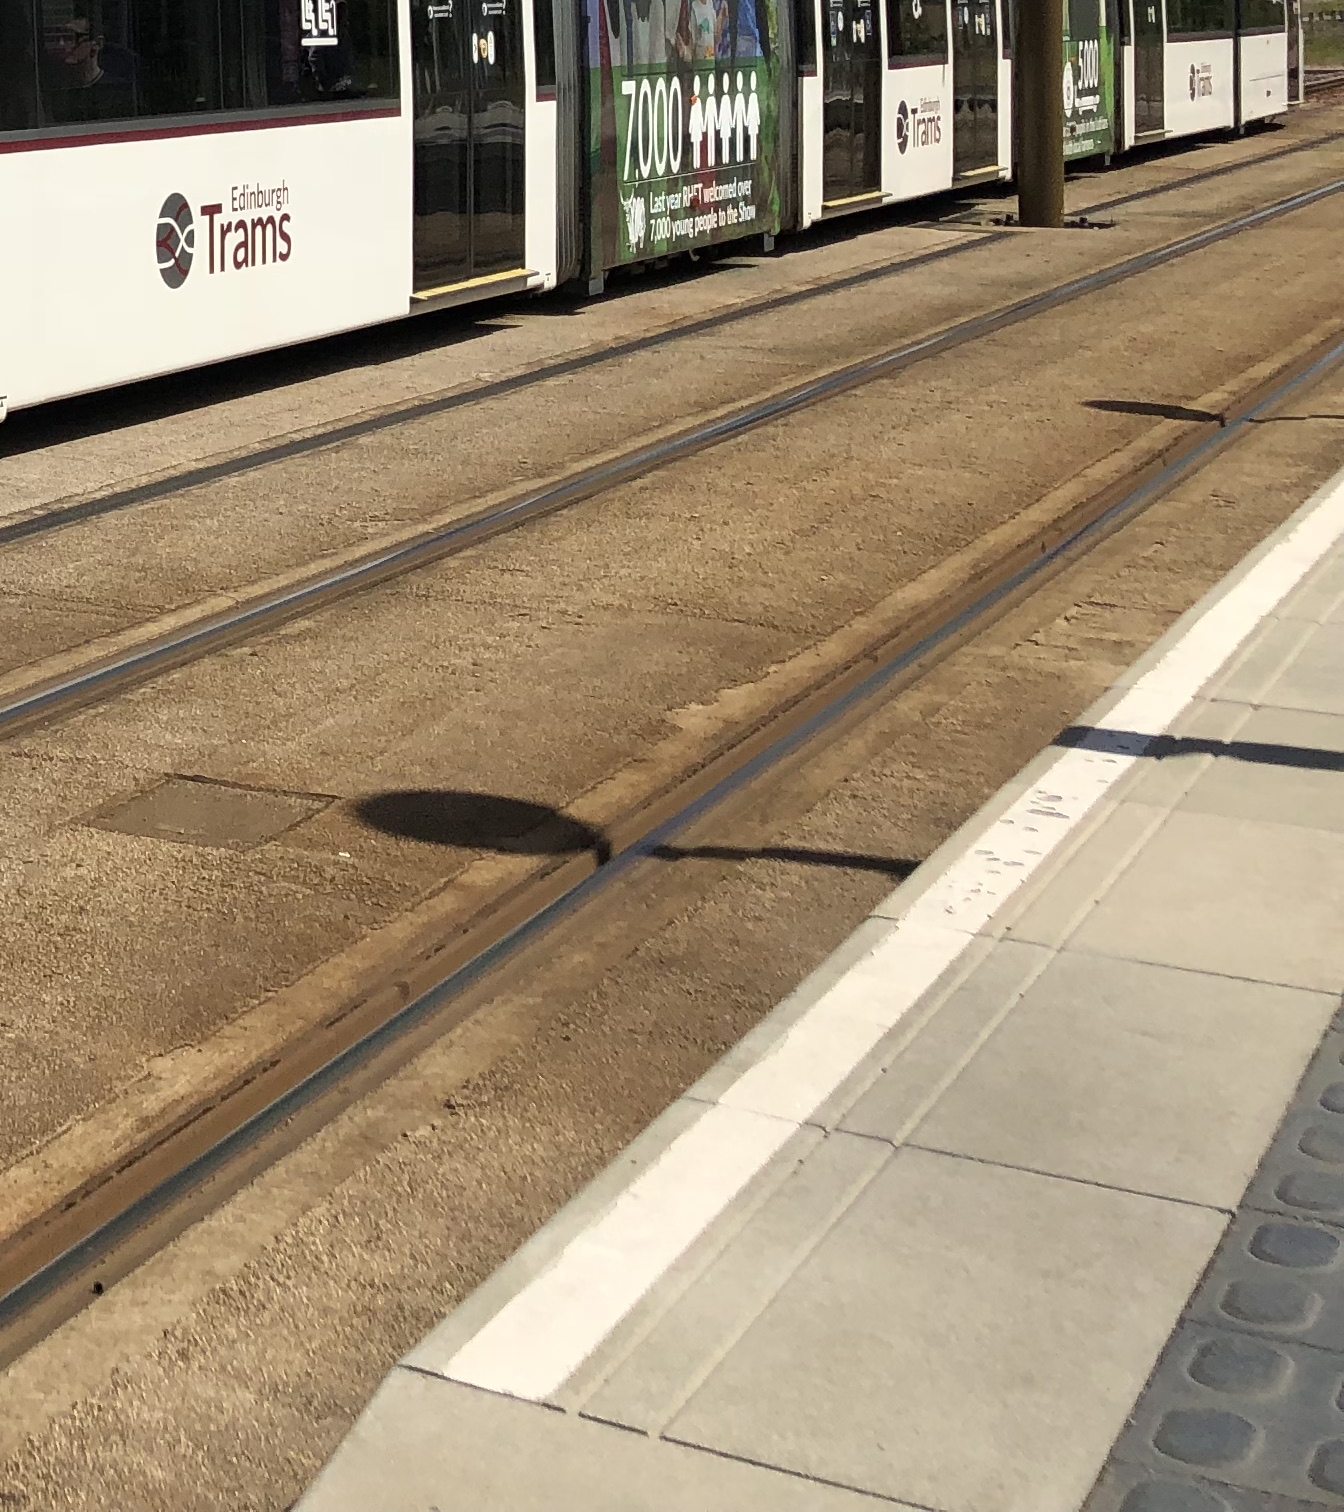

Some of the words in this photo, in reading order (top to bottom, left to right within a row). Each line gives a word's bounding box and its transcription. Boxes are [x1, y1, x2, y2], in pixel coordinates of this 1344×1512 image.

[621, 76, 683, 188] 7,000
[911, 108, 941, 148] Trams
[231, 179, 289, 212] Edinburgh
[650, 191, 665, 213] Last
[666, 193, 681, 215] year
[703, 177, 737, 203] welcomed
[738, 179, 752, 197] over
[200, 203, 292, 275] Trams
[650, 216, 670, 244] 7,000
[672, 217, 693, 242] young
[694, 207, 717, 236] people
[718, 208, 726, 227] to
[727, 203, 738, 225] the
[739, 201, 756, 223] Show
